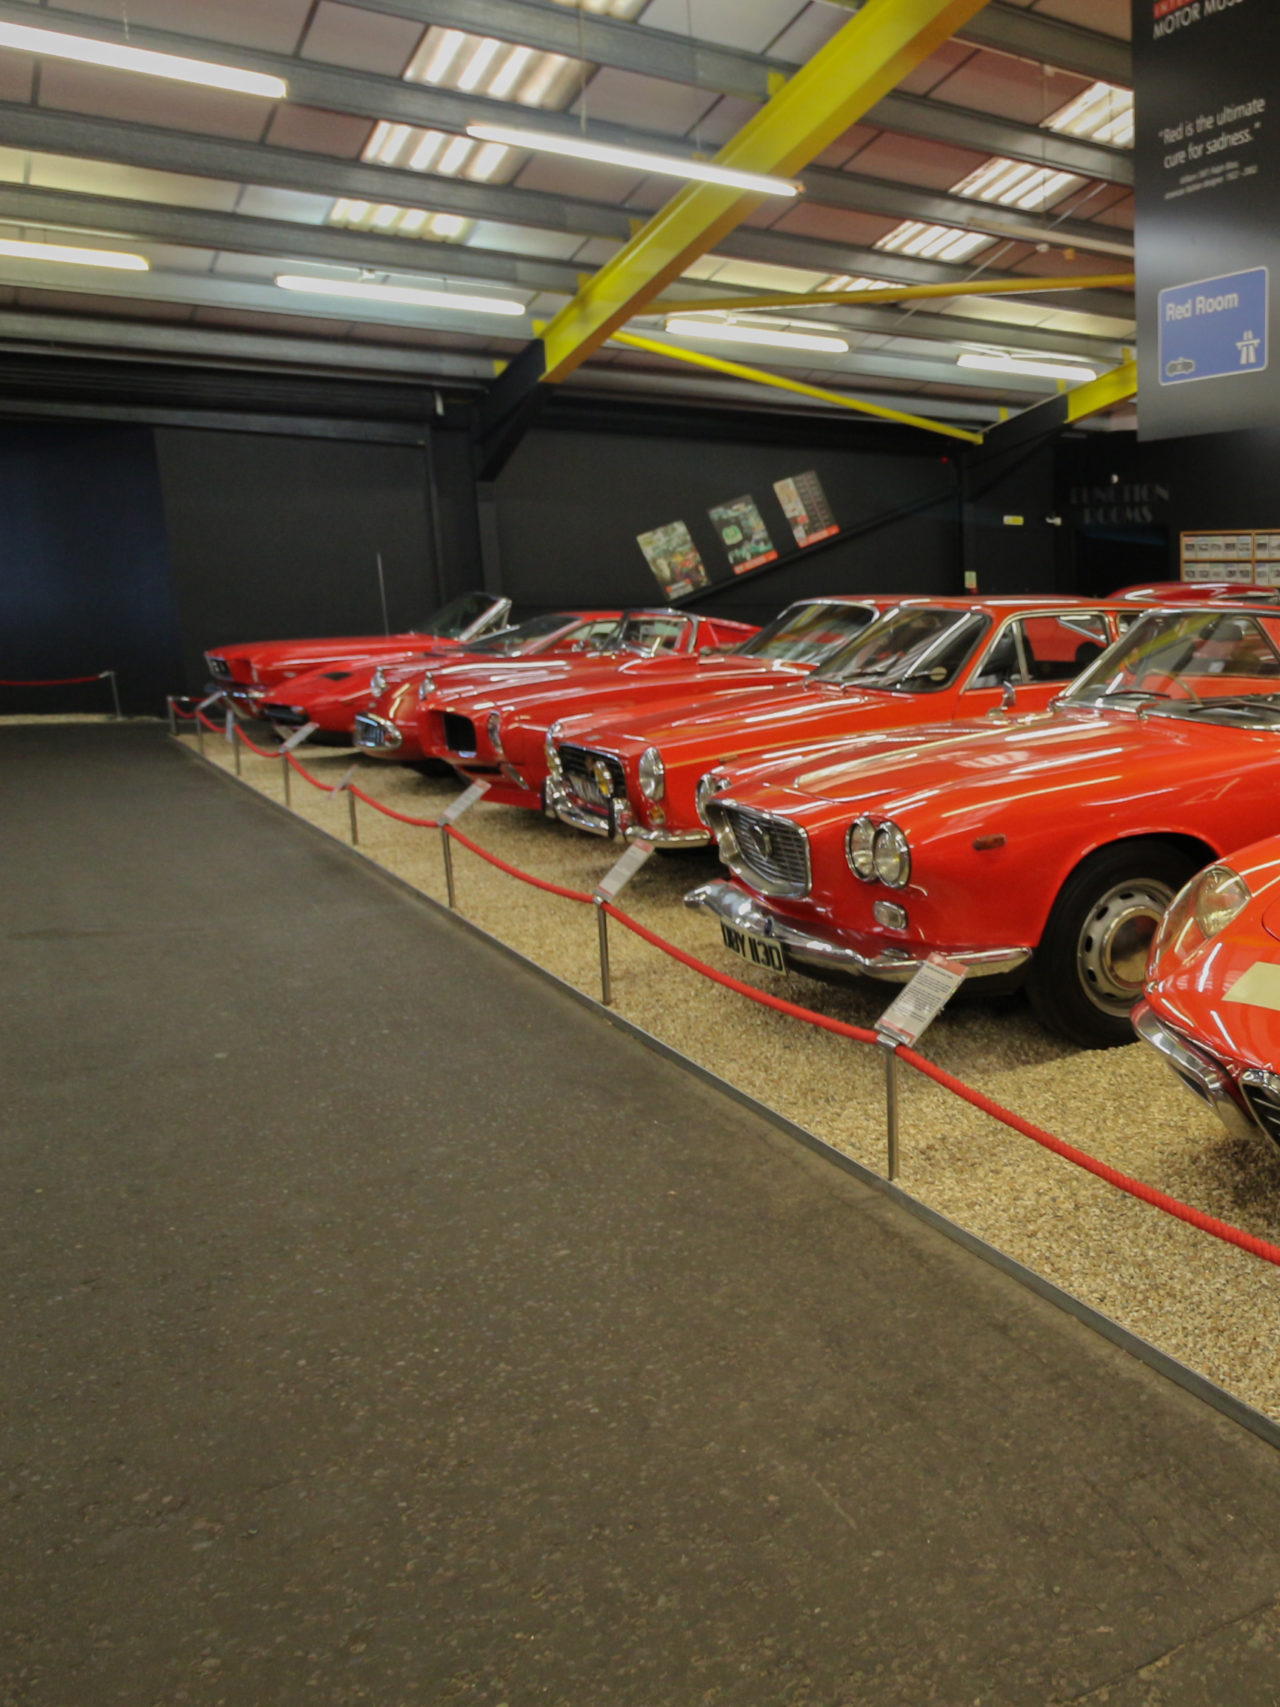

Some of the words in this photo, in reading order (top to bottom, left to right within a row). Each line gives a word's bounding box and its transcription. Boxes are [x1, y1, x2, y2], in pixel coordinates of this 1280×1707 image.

[1152, 1, 1201, 41] MOTOR
[1184, 119, 1194, 137] is
[1195, 113, 1215, 133] the
[1216, 97, 1266, 126] ultimate
[1163, 150, 1187, 169] cure
[1187, 142, 1204, 160] for
[1165, 299, 1192, 322] Red
[1195, 292, 1239, 315] Room
